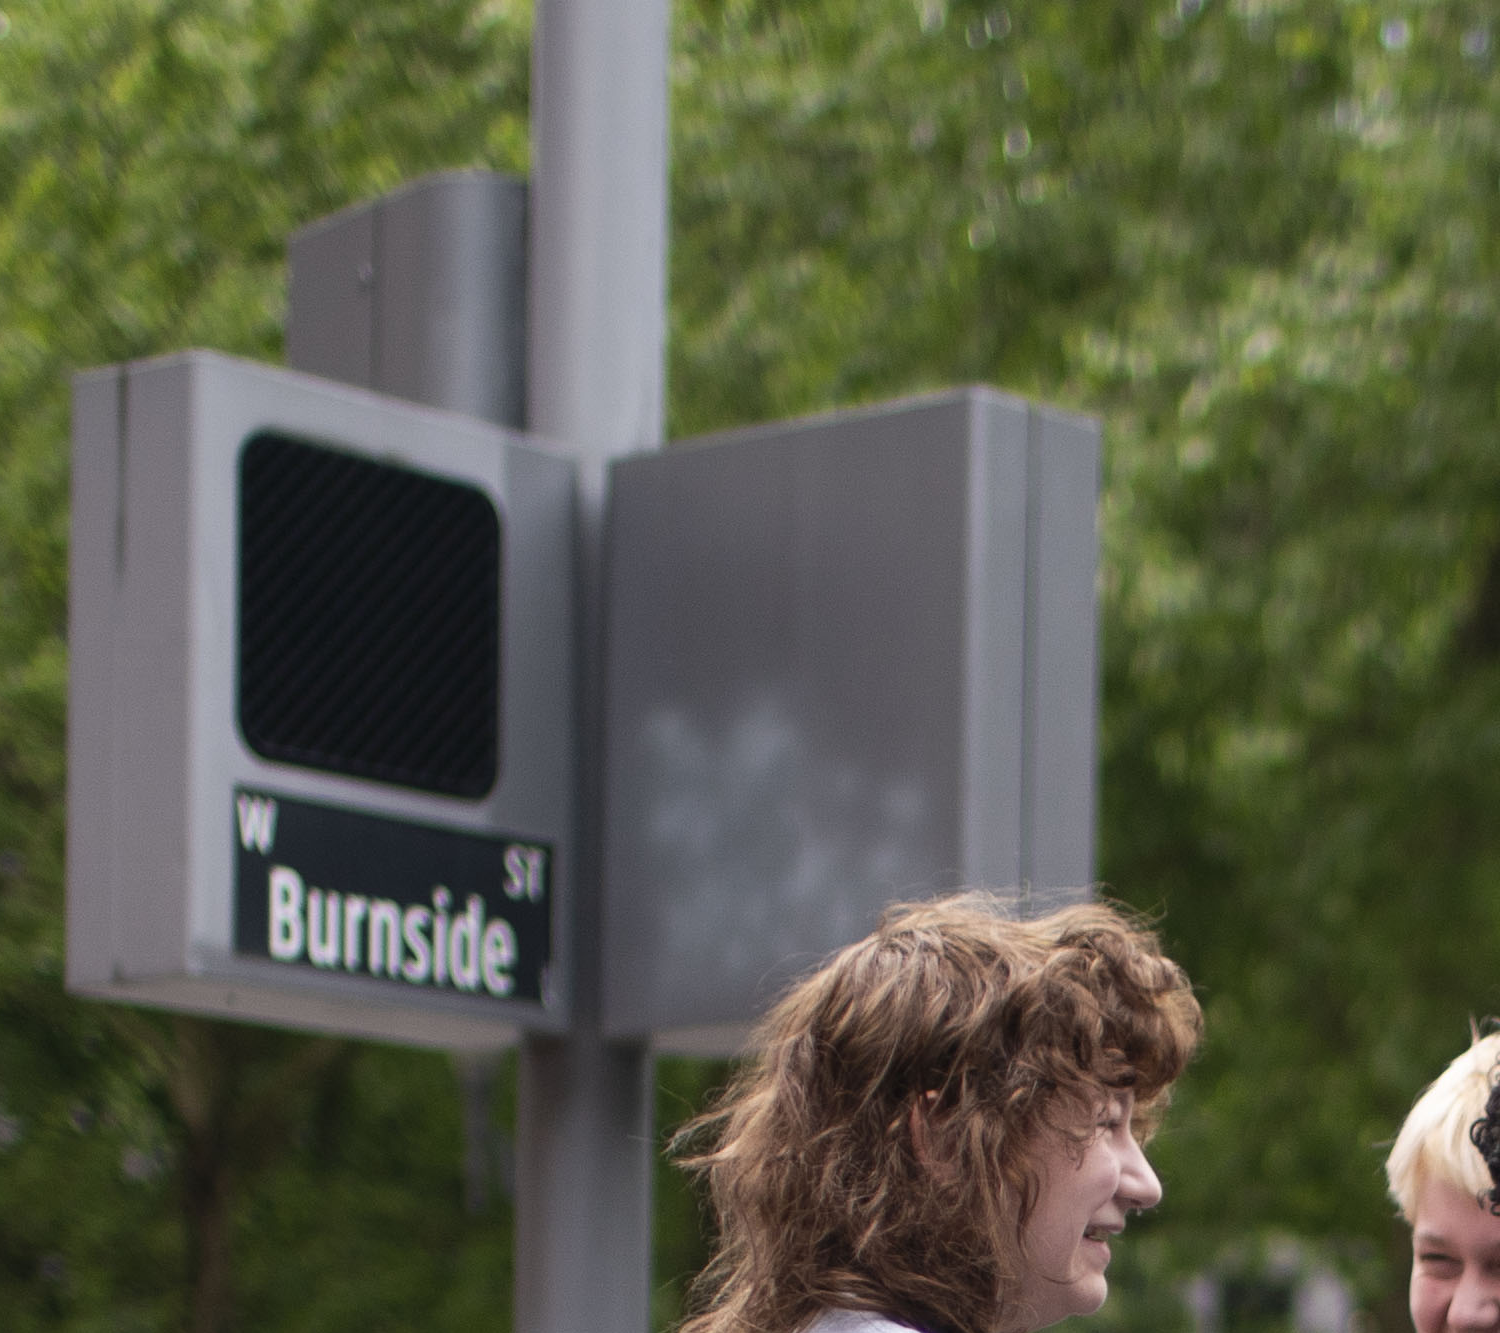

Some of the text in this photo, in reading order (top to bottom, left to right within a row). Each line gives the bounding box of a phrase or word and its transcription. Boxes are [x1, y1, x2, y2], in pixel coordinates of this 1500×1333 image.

[237, 794, 546, 902] W ST
[268, 865, 517, 997] Burnside
